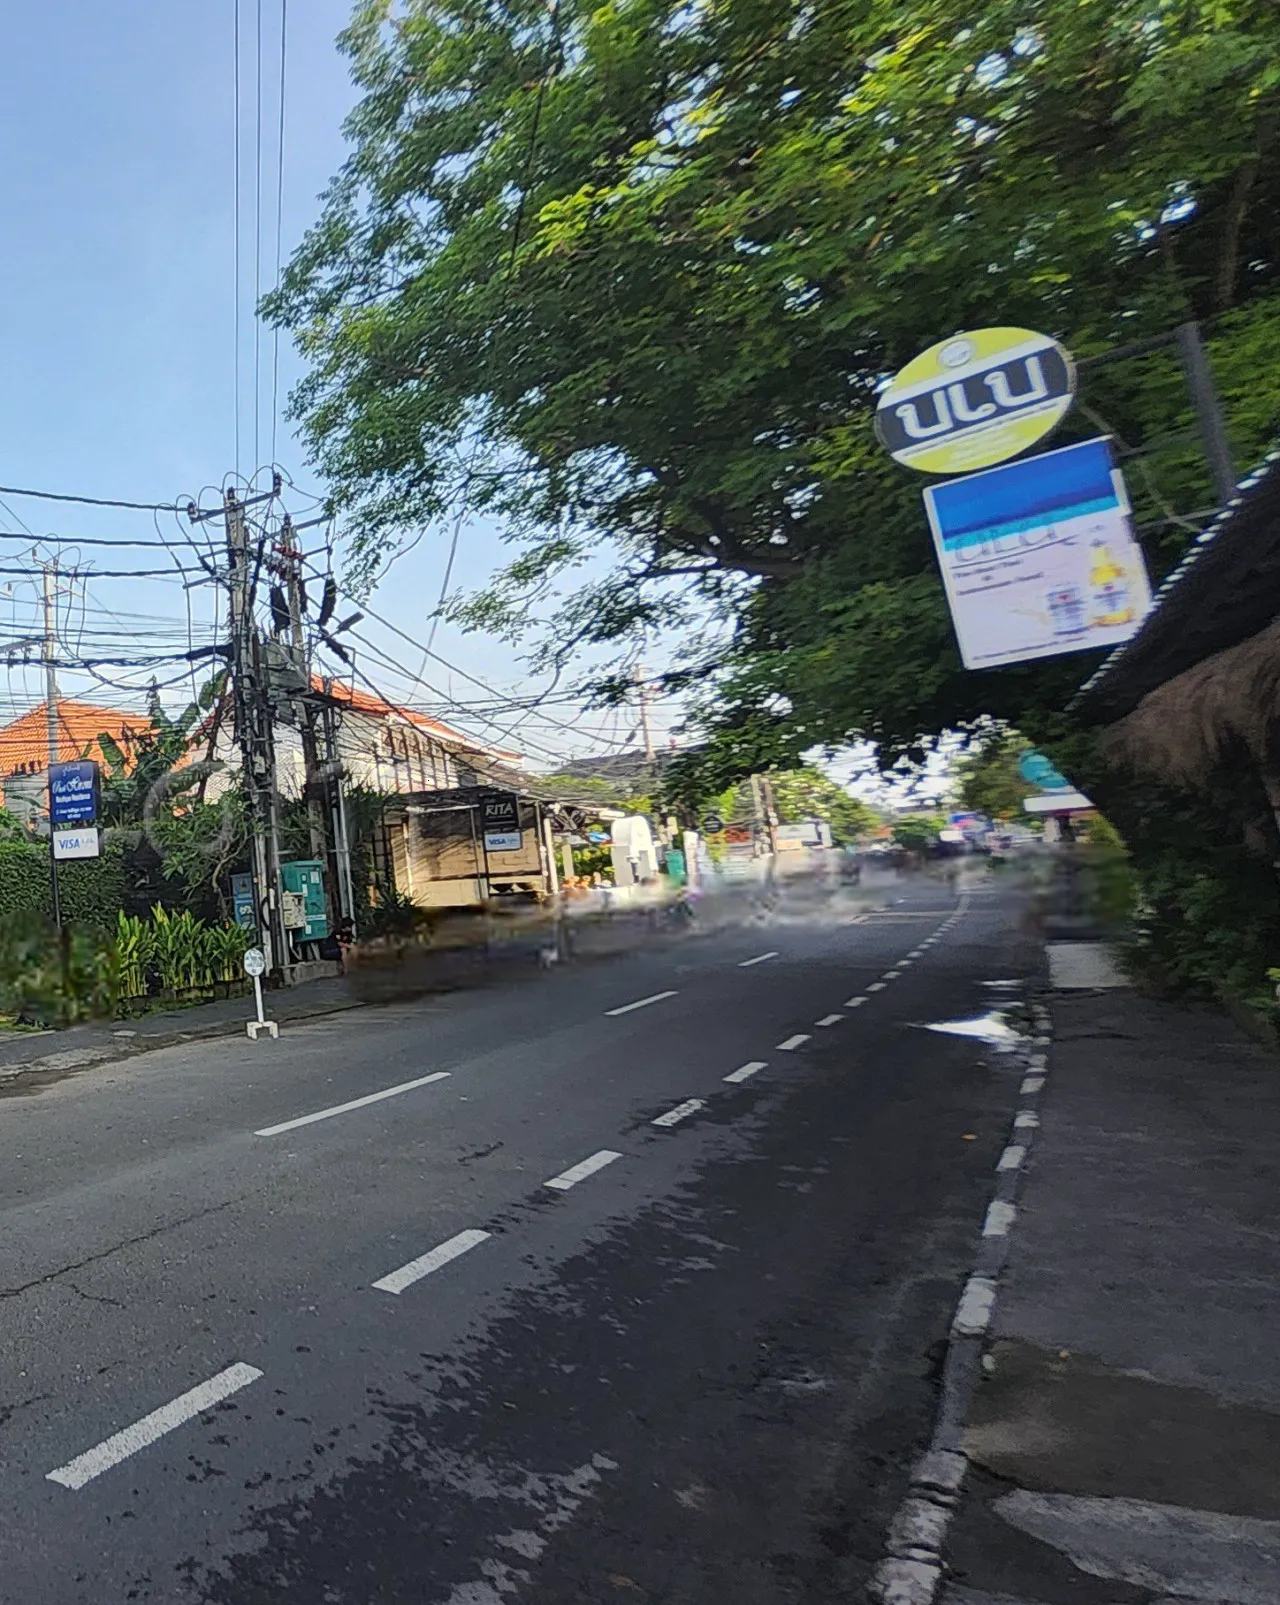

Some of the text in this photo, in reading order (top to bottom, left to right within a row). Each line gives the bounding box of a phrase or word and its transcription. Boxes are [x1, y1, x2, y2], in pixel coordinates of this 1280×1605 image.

[895, 356, 1049, 438] ULU
[485, 802, 514, 816] RITA
[58, 838, 80, 850] VISA
